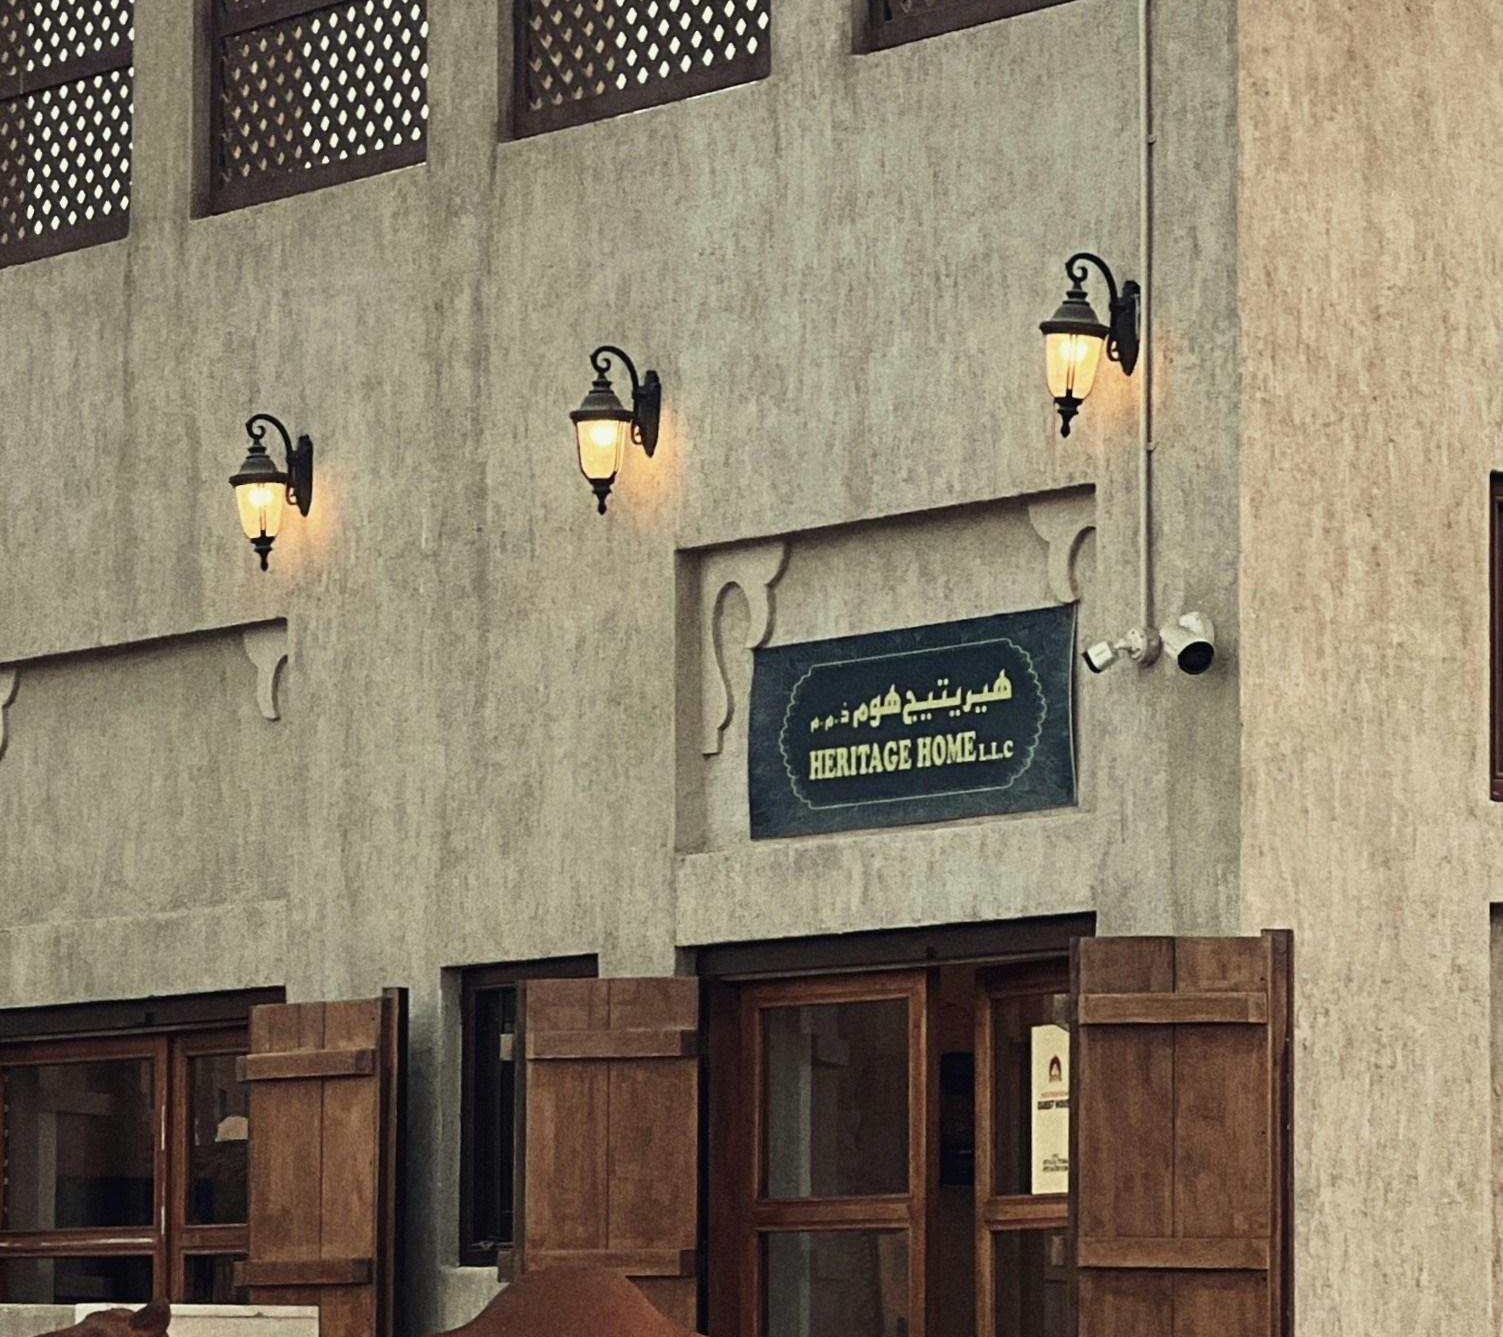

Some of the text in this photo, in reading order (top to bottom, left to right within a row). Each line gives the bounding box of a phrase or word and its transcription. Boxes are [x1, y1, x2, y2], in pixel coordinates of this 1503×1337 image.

[853, 683, 902, 728] هوم
[903, 668, 1013, 725] هيريتيج
[809, 738, 912, 781] HERITAGE
[916, 730, 977, 768] HOME
